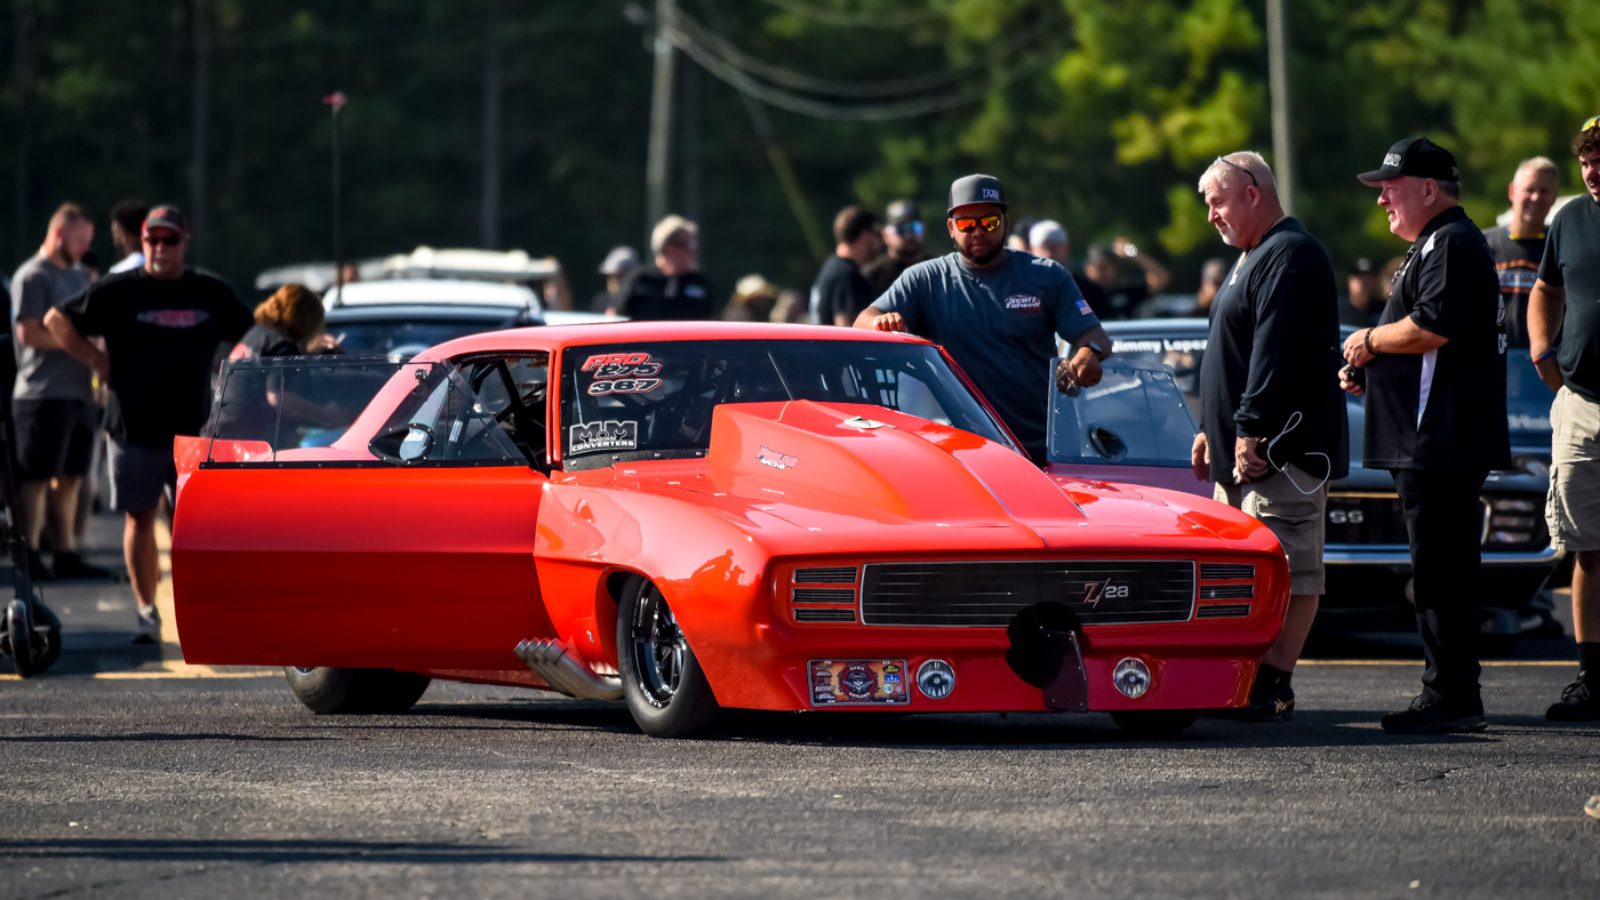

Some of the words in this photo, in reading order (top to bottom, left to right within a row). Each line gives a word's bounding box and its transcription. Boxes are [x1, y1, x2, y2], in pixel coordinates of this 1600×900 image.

[1111, 339, 1162, 354] Jimmy
[581, 352, 651, 371] PRO
[593, 362, 663, 379] 275
[571, 440, 635, 452] CONVERTERS
[1329, 509, 1364, 524] SS
